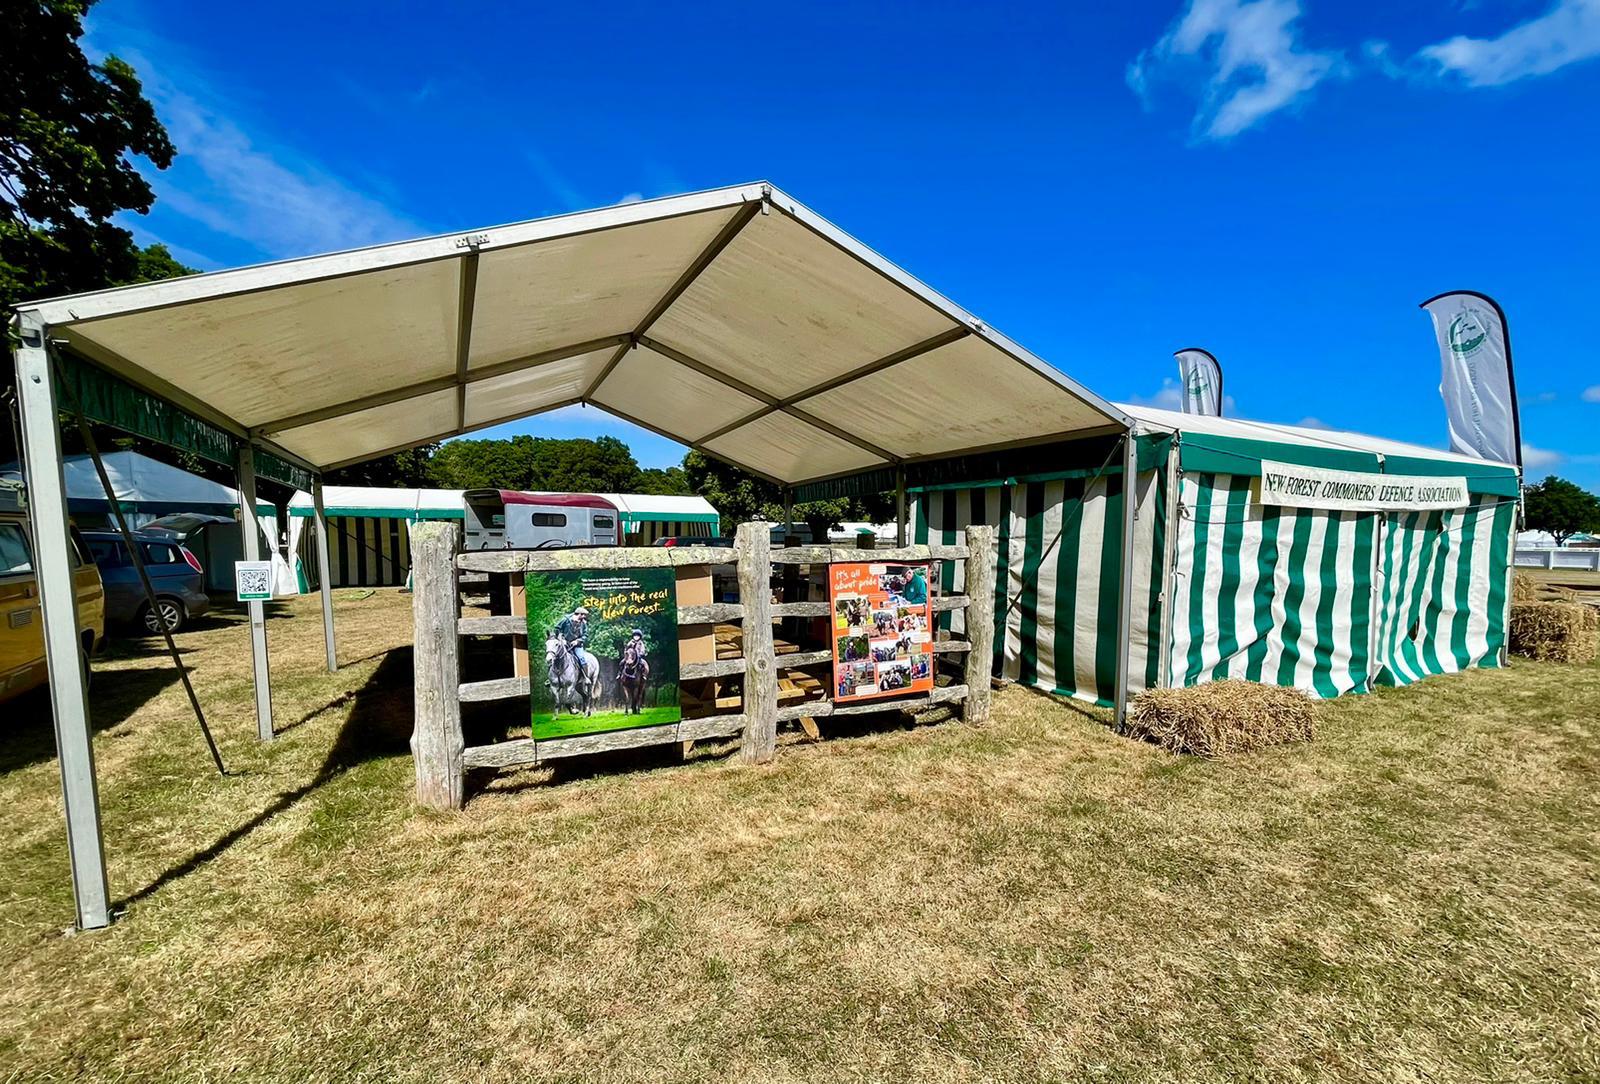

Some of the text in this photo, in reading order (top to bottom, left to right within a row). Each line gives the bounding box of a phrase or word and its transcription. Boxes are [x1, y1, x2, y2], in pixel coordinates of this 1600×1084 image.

[1264, 472, 1462, 503] NEW FOREST COMMONERS DEFENCE ASSOCIATION
[850, 569, 861, 578] all
[834, 576, 877, 592] about pride
[609, 593, 628, 605] into
[630, 591, 646, 603] the
[649, 588, 668, 600] real
[602, 605, 627, 620] New
